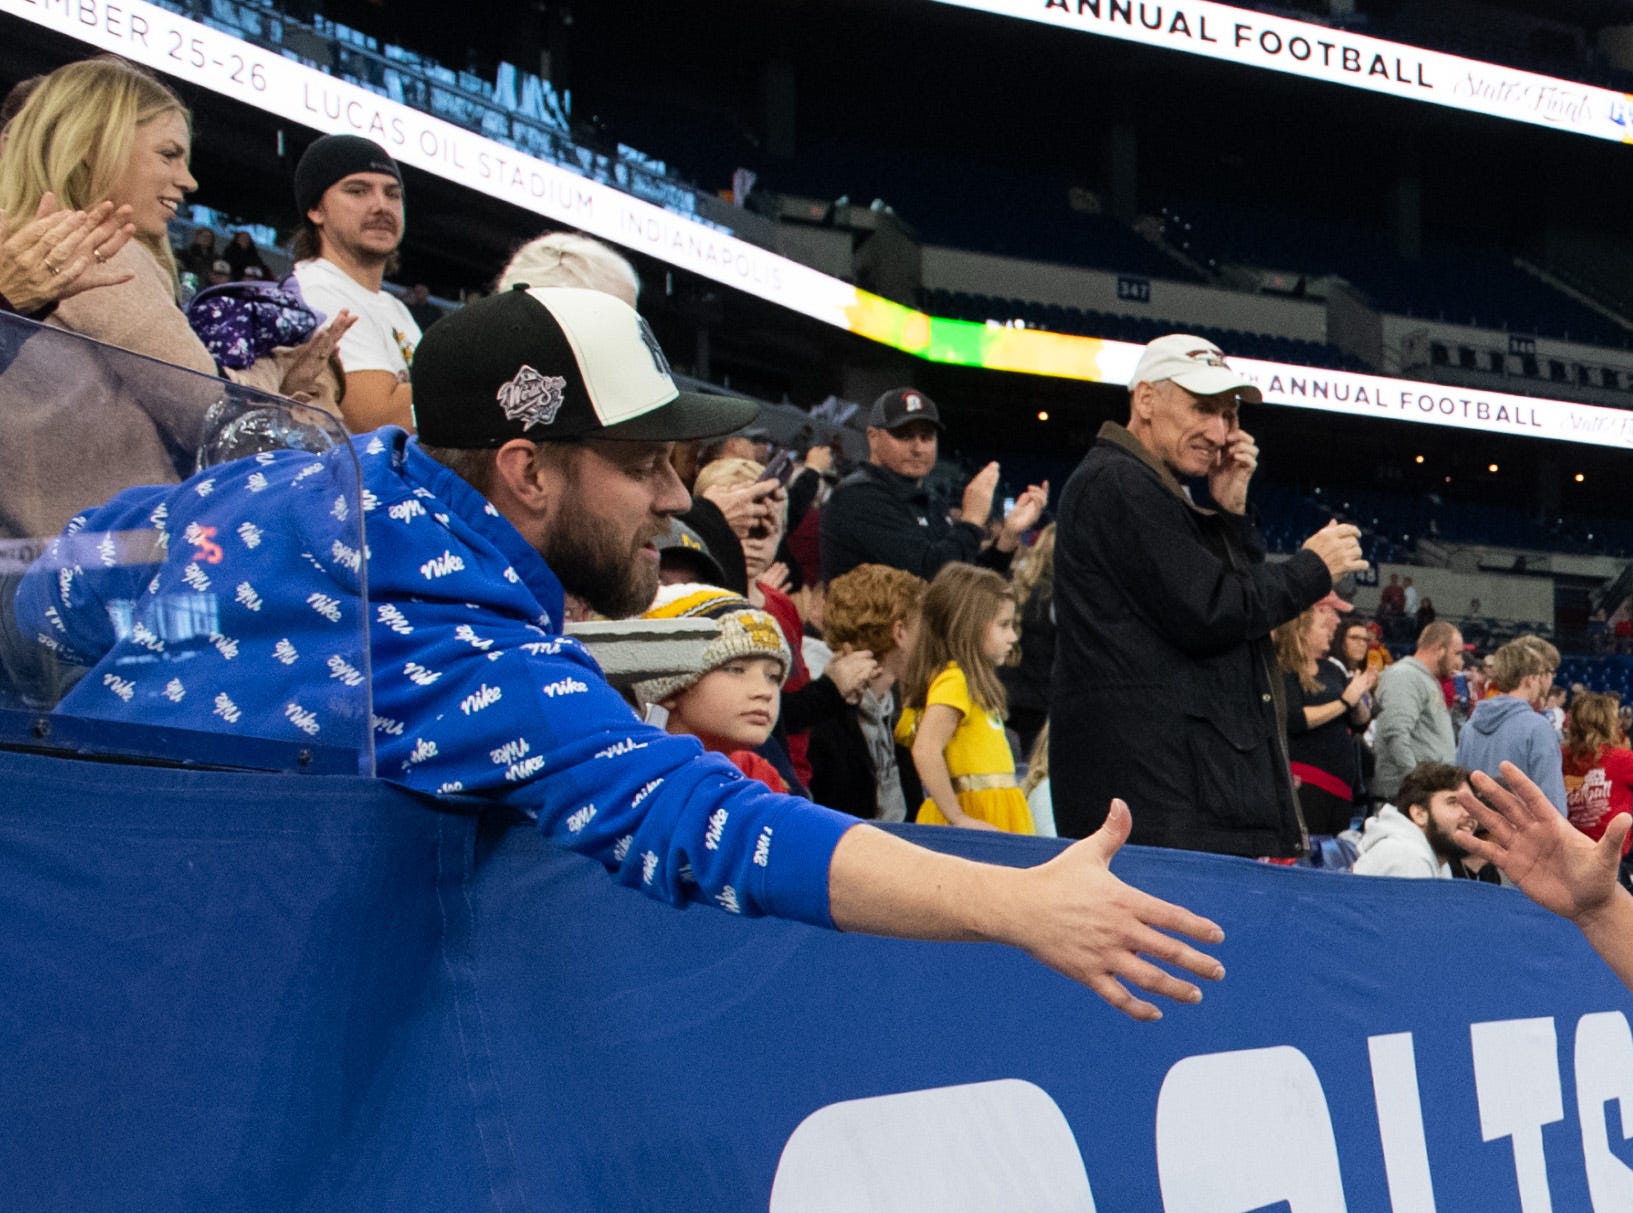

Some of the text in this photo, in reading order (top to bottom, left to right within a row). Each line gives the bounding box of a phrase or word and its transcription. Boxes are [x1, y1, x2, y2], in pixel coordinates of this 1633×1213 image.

[1233, 25, 1435, 89] FOOTBALL
[167, 29, 267, 92] 25-26
[303, 80, 406, 145] LUCAS
[418, 130, 466, 170] OIL
[477, 151, 595, 218] STADIUM
[619, 207, 784, 292] INDIANAPOLIS
[1268, 374, 1389, 409] ANNUAL
[1401, 391, 1542, 428] FOOTBALL
